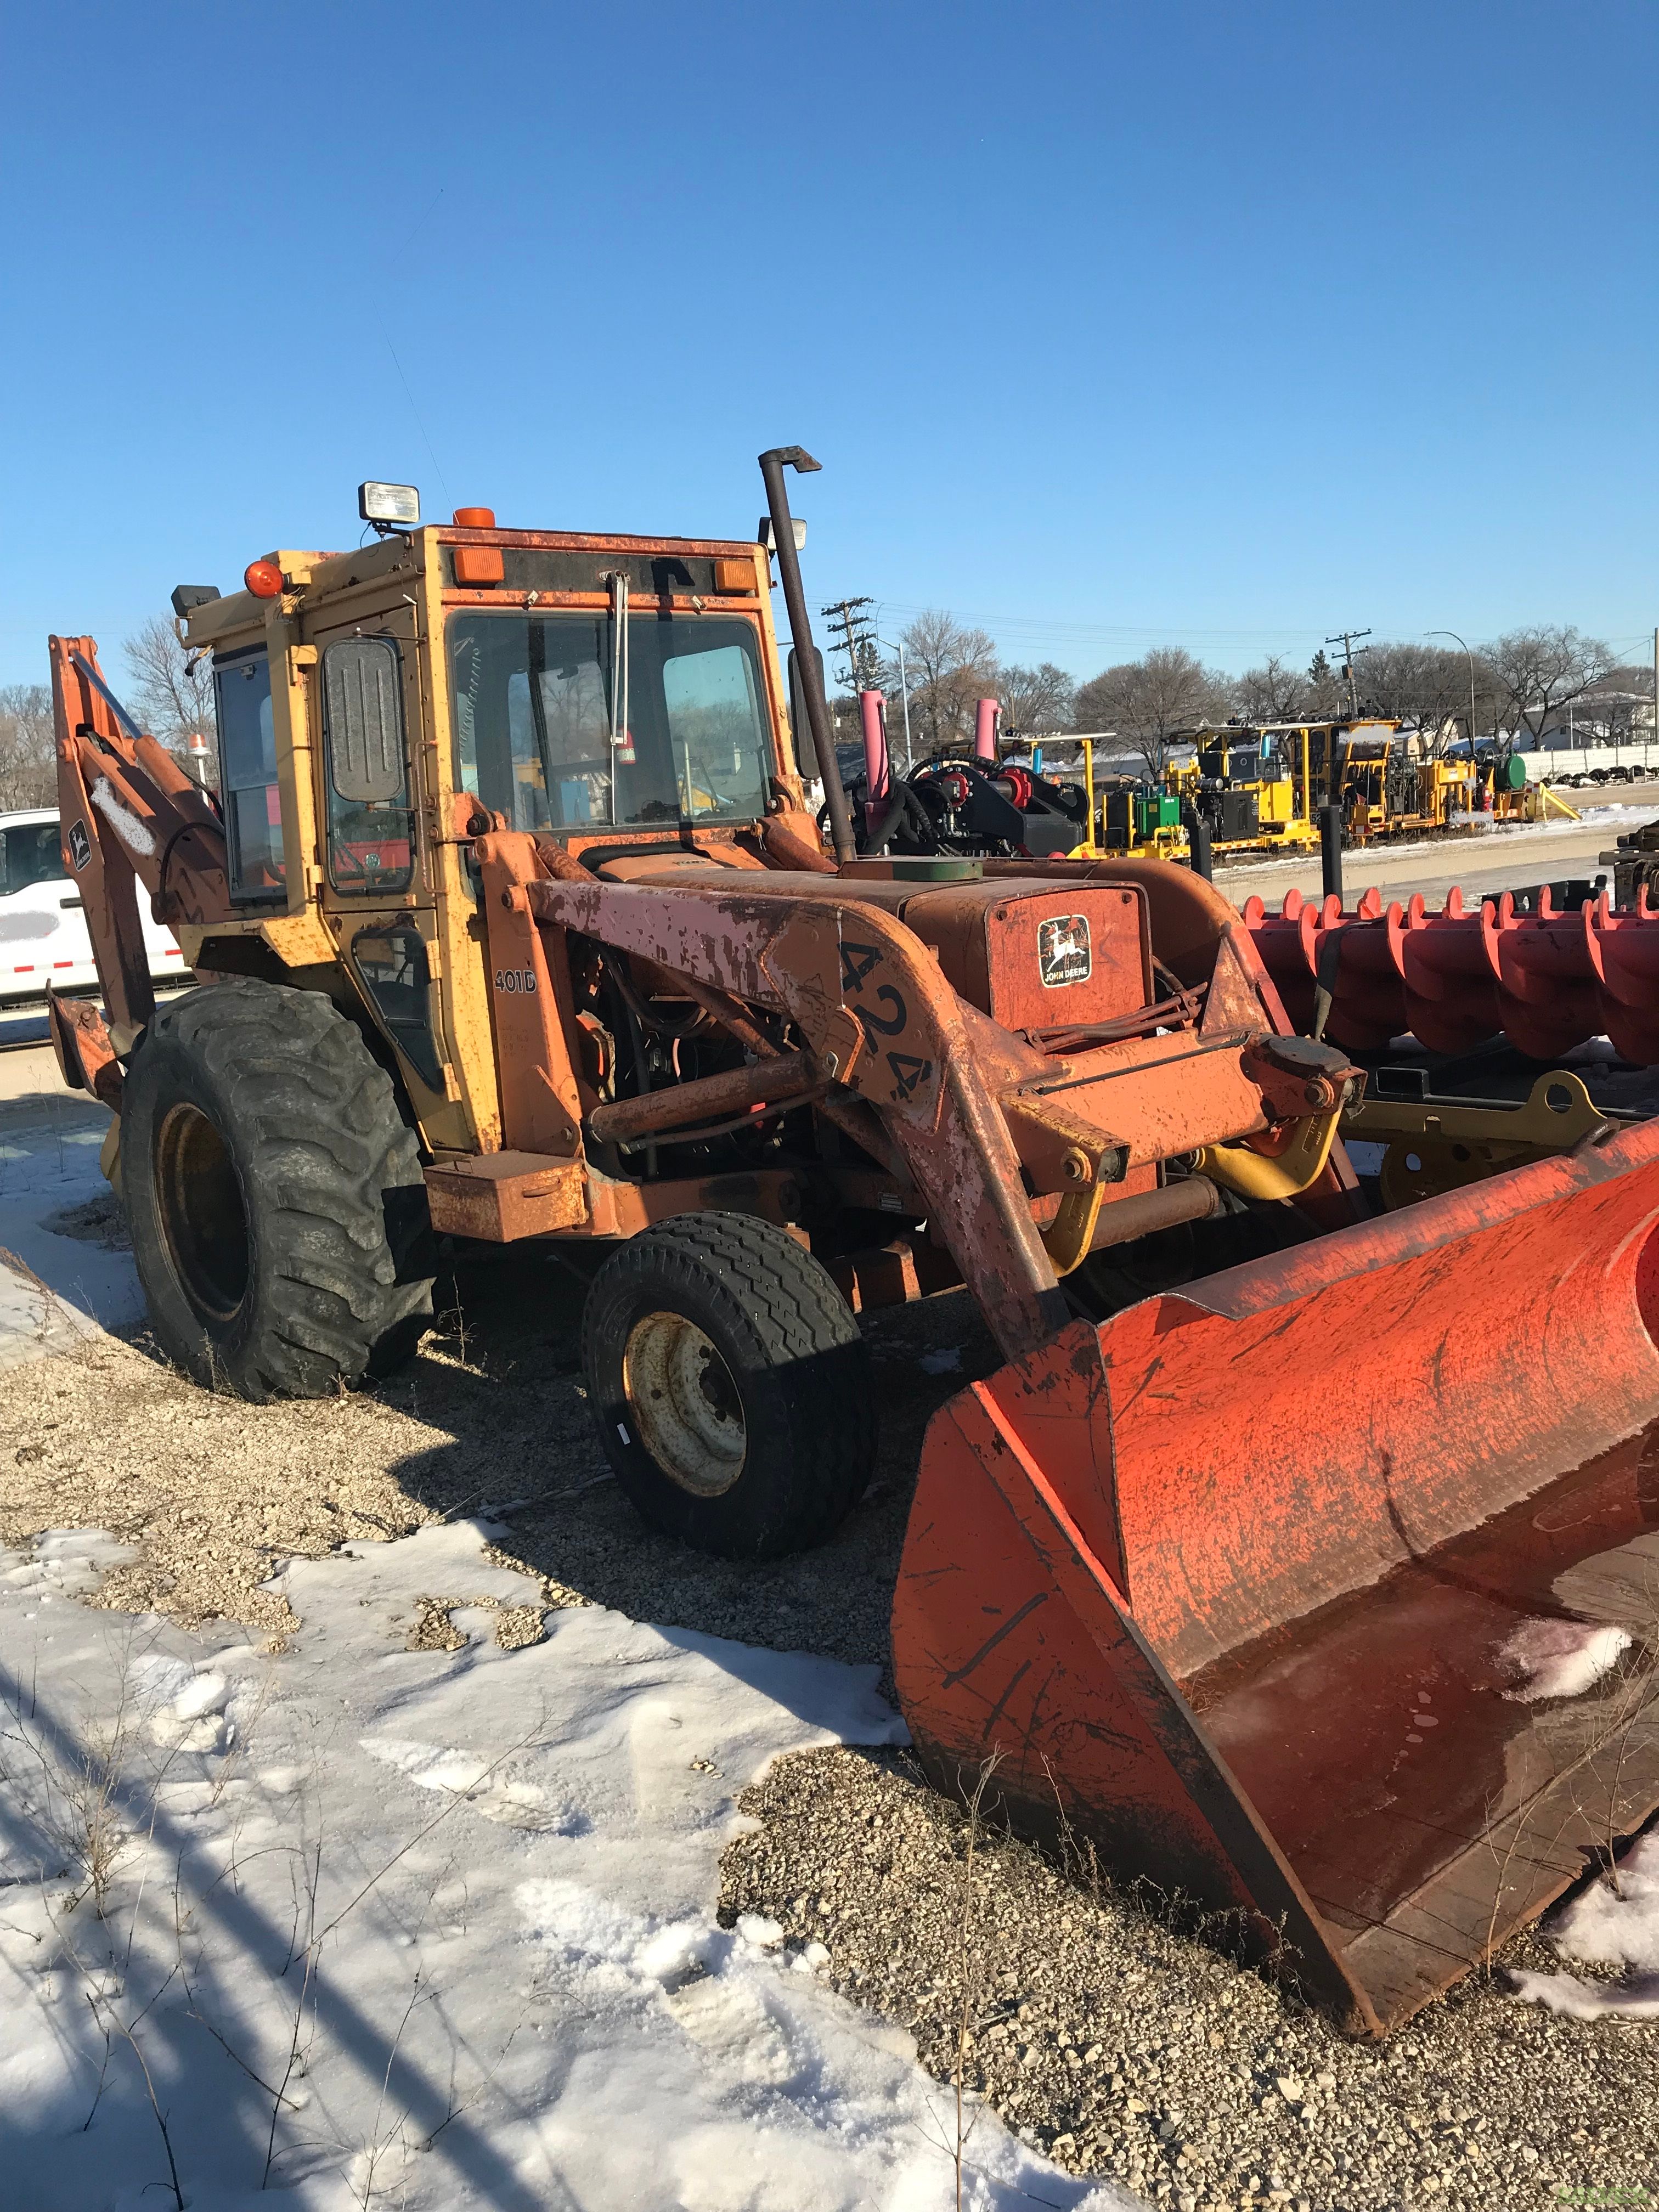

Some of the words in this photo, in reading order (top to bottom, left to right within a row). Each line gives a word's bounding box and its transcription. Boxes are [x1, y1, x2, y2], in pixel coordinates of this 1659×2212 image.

[494, 969, 537, 994] 401D
[1045, 970, 1064, 982] JOHN
[1065, 966, 1087, 978] DEERE
[837, 941, 933, 1103] 424
